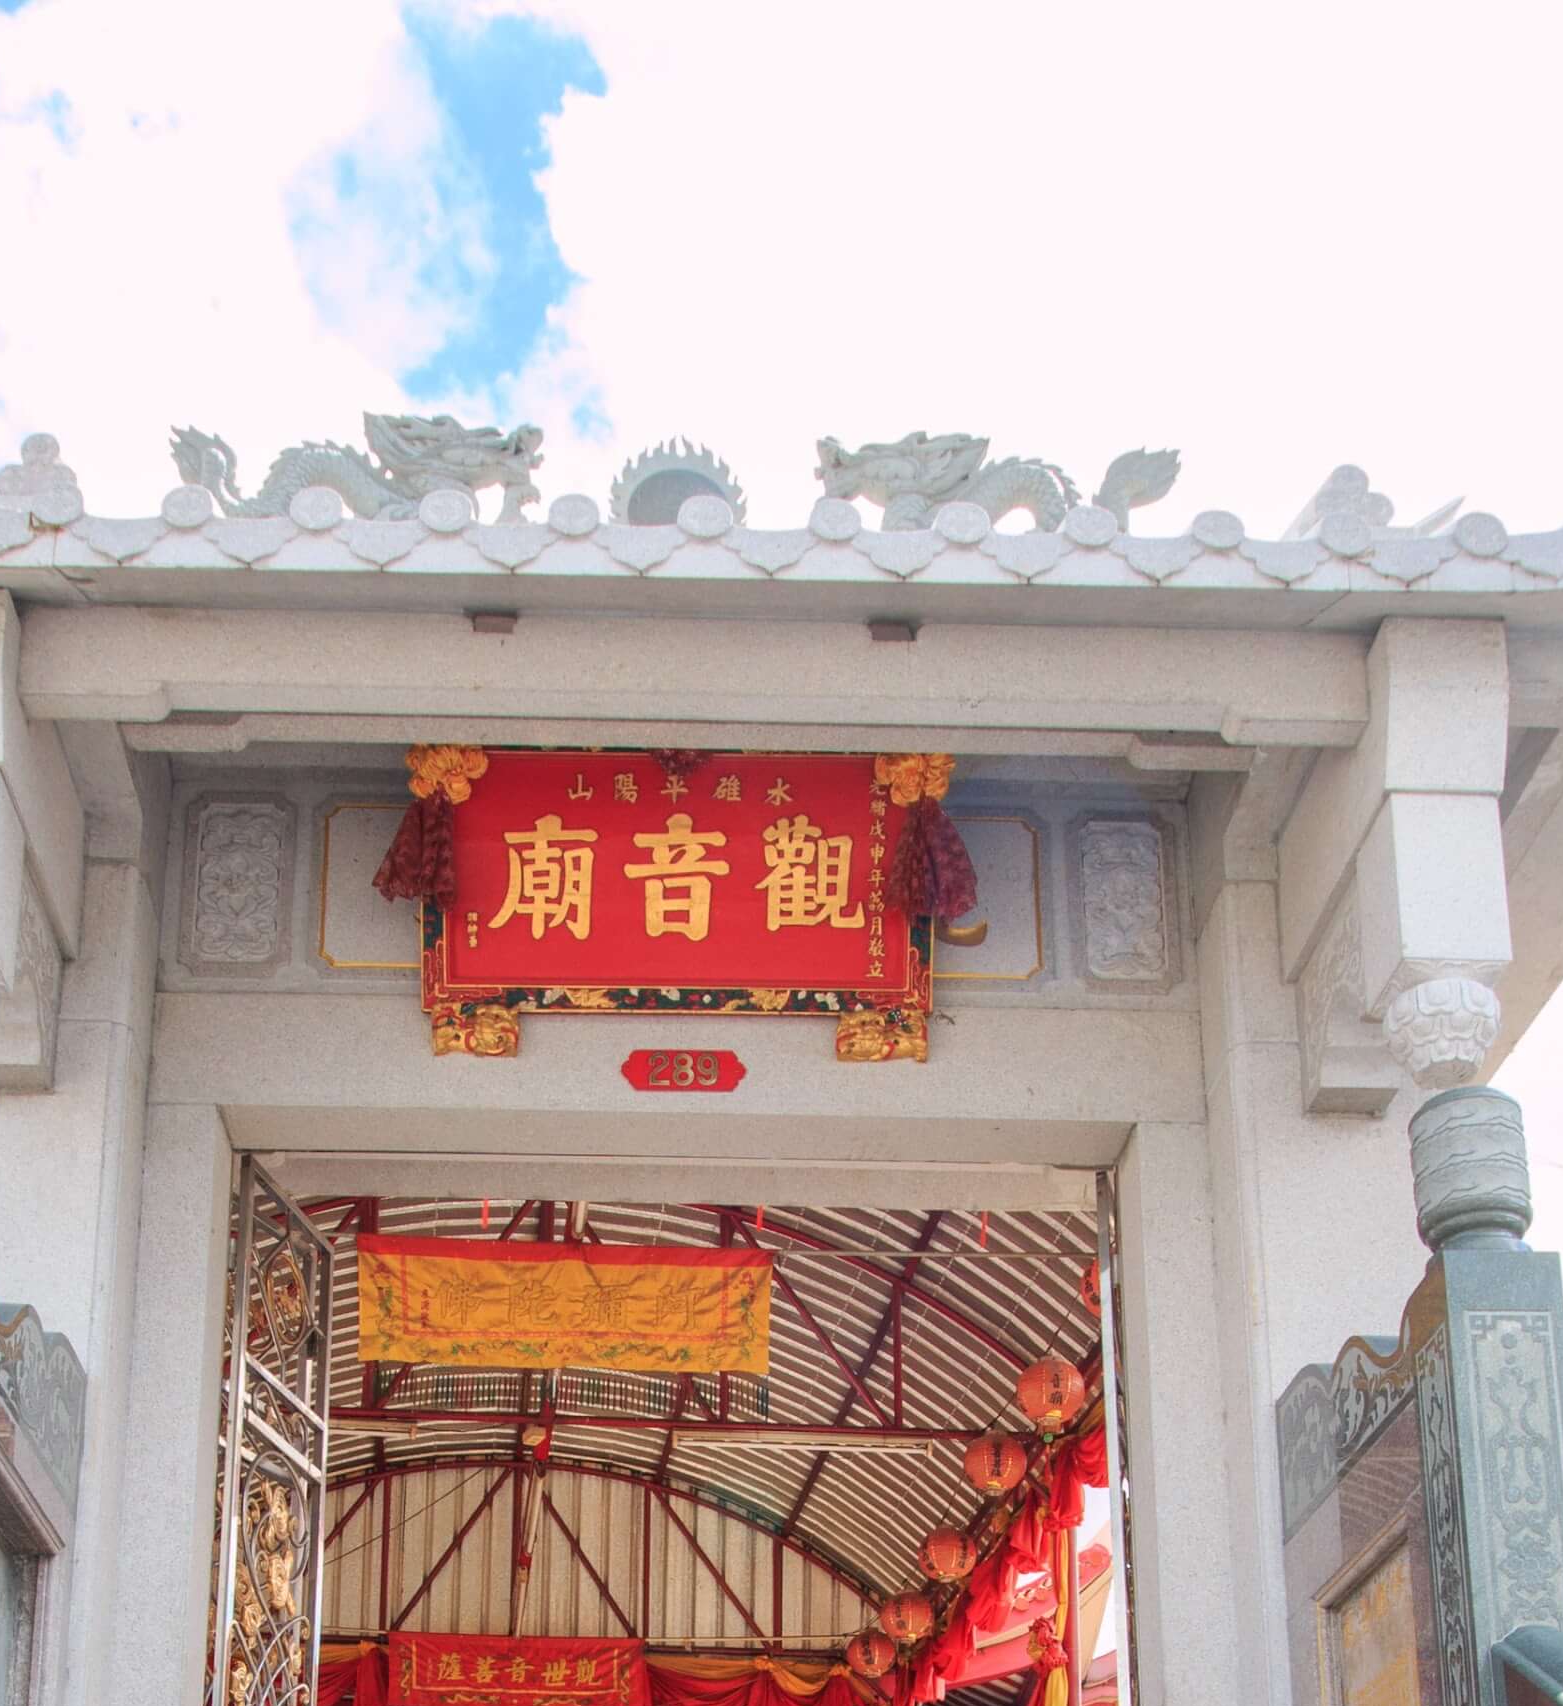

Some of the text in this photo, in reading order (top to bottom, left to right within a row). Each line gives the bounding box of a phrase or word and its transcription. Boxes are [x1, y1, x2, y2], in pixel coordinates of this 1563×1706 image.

[488, 813, 865, 941] 觀音廟
[647, 1053, 719, 1087] 289
